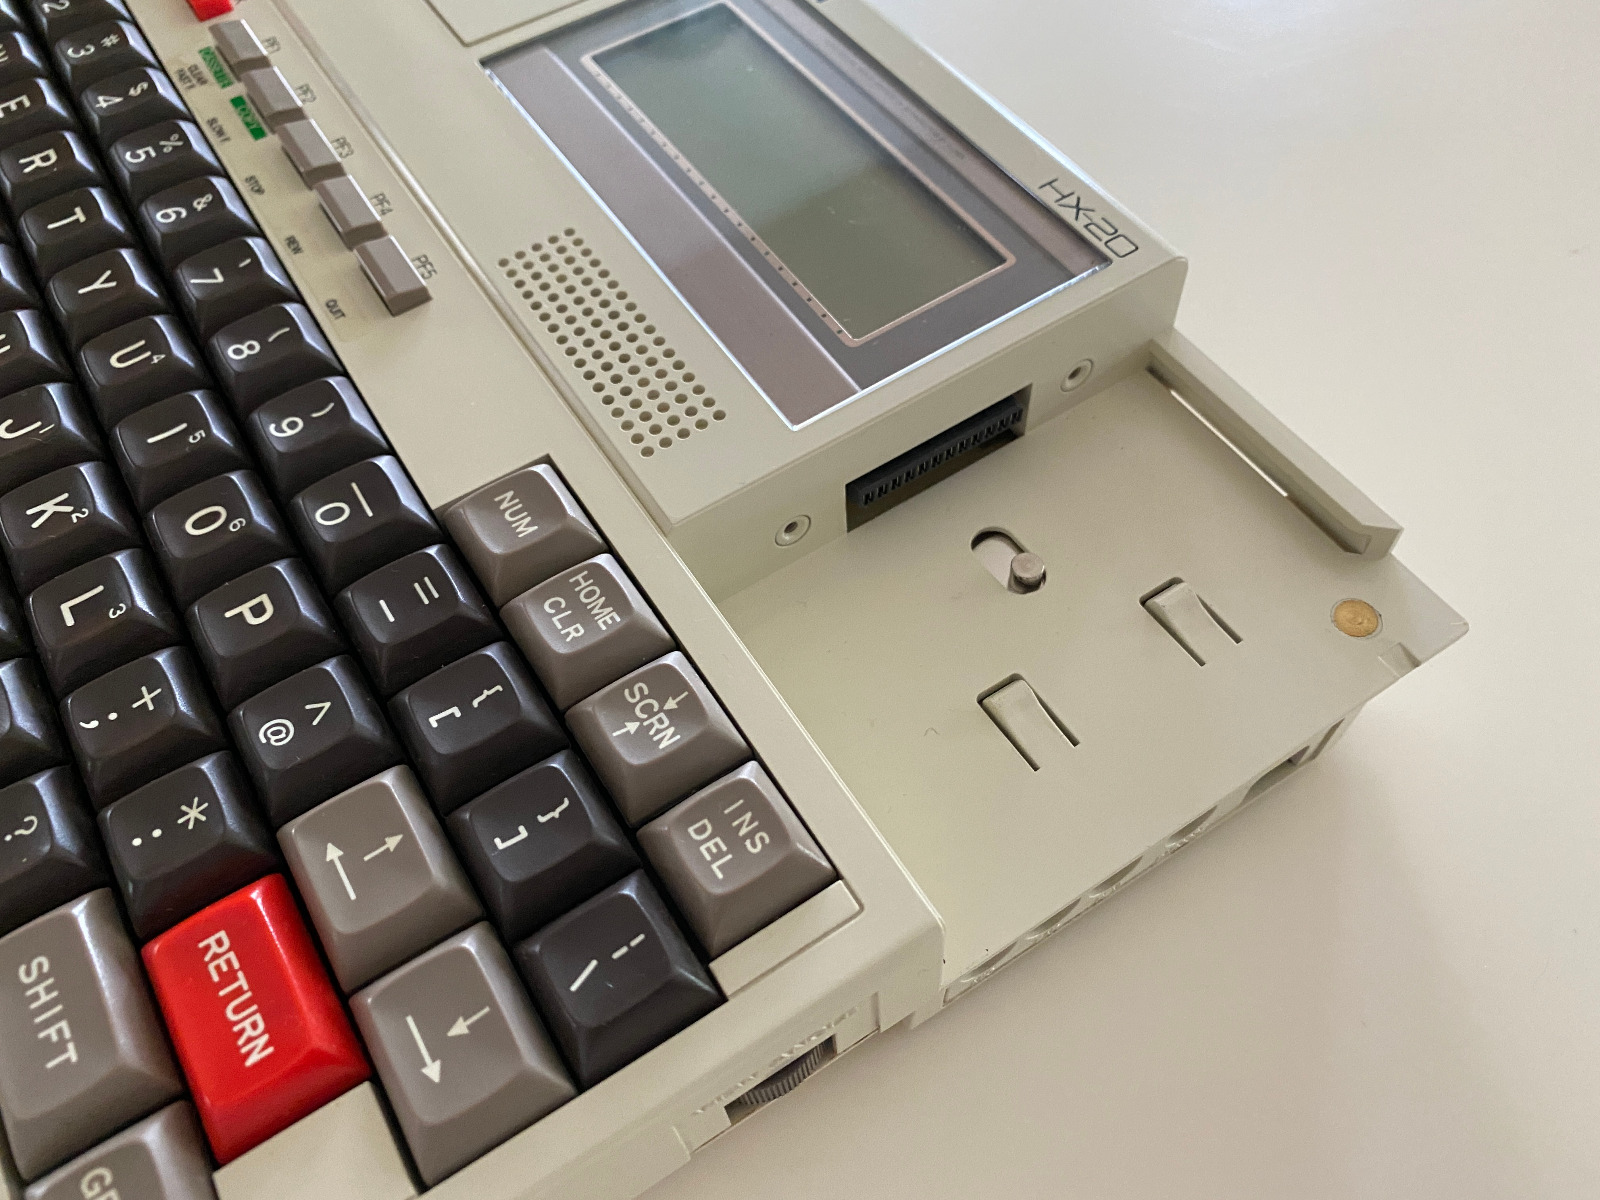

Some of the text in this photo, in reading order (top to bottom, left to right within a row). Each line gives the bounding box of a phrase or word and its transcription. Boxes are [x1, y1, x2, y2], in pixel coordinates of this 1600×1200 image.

[66, 45, 95, 58] 3
[100, 34, 120, 47] #
[128, 81, 149, 97] $
[296, 83, 317, 103] PF2
[95, 95, 123, 109] 4
[159, 133, 184, 153] %
[331, 136, 354, 159] PF3
[18, 148, 57, 173] R
[124, 146, 156, 164] 5
[244, 175, 266, 196] STOP
[192, 193, 213, 212] &
[371, 192, 394, 216] PF4
[47, 206, 86, 230] T
[155, 207, 187, 224] 6
[1036, 178, 1139, 260] HX-20
[284, 235, 304, 255] REW
[189, 267, 224, 284] 7
[411, 254, 438, 280] PF5
[77, 270, 117, 294] Y
[325, 299, 346, 320] QUIT
[267, 327, 290, 343] (
[109, 339, 152, 369] U
[151, 354, 166, 364] 4
[226, 340, 261, 361] 8
[311, 402, 335, 418] )
[0, 418, 42, 439] J
[146, 422, 188, 444] I
[188, 429, 206, 444] 5
[268, 416, 304, 438] 9
[25, 492, 74, 529] K
[69, 505, 89, 524] 2
[184, 505, 227, 536] O
[494, 490, 539, 538] NUM
[228, 517, 246, 532] 6
[413, 576, 440, 605] =
[568, 569, 621, 631] HOME
[59, 585, 105, 627] L
[108, 603, 127, 619] 3
[224, 593, 274, 625] P
[378, 599, 395, 623] -
[543, 596, 585, 642] CLR
[131, 685, 162, 711] +
[472, 684, 504, 708] {
[78, 712, 118, 729] ;
[428, 706, 462, 728] [
[623, 682, 681, 750] SCRN
[258, 718, 295, 747] @
[536, 797, 570, 823] }
[4, 815, 38, 842] ?
[131, 828, 162, 847] :
[493, 825, 529, 850] ]
[723, 799, 770, 855] INS
[687, 818, 733, 880] DEL
[198, 927, 278, 1067] RETURN
[18, 956, 79, 1069] SHIFT
